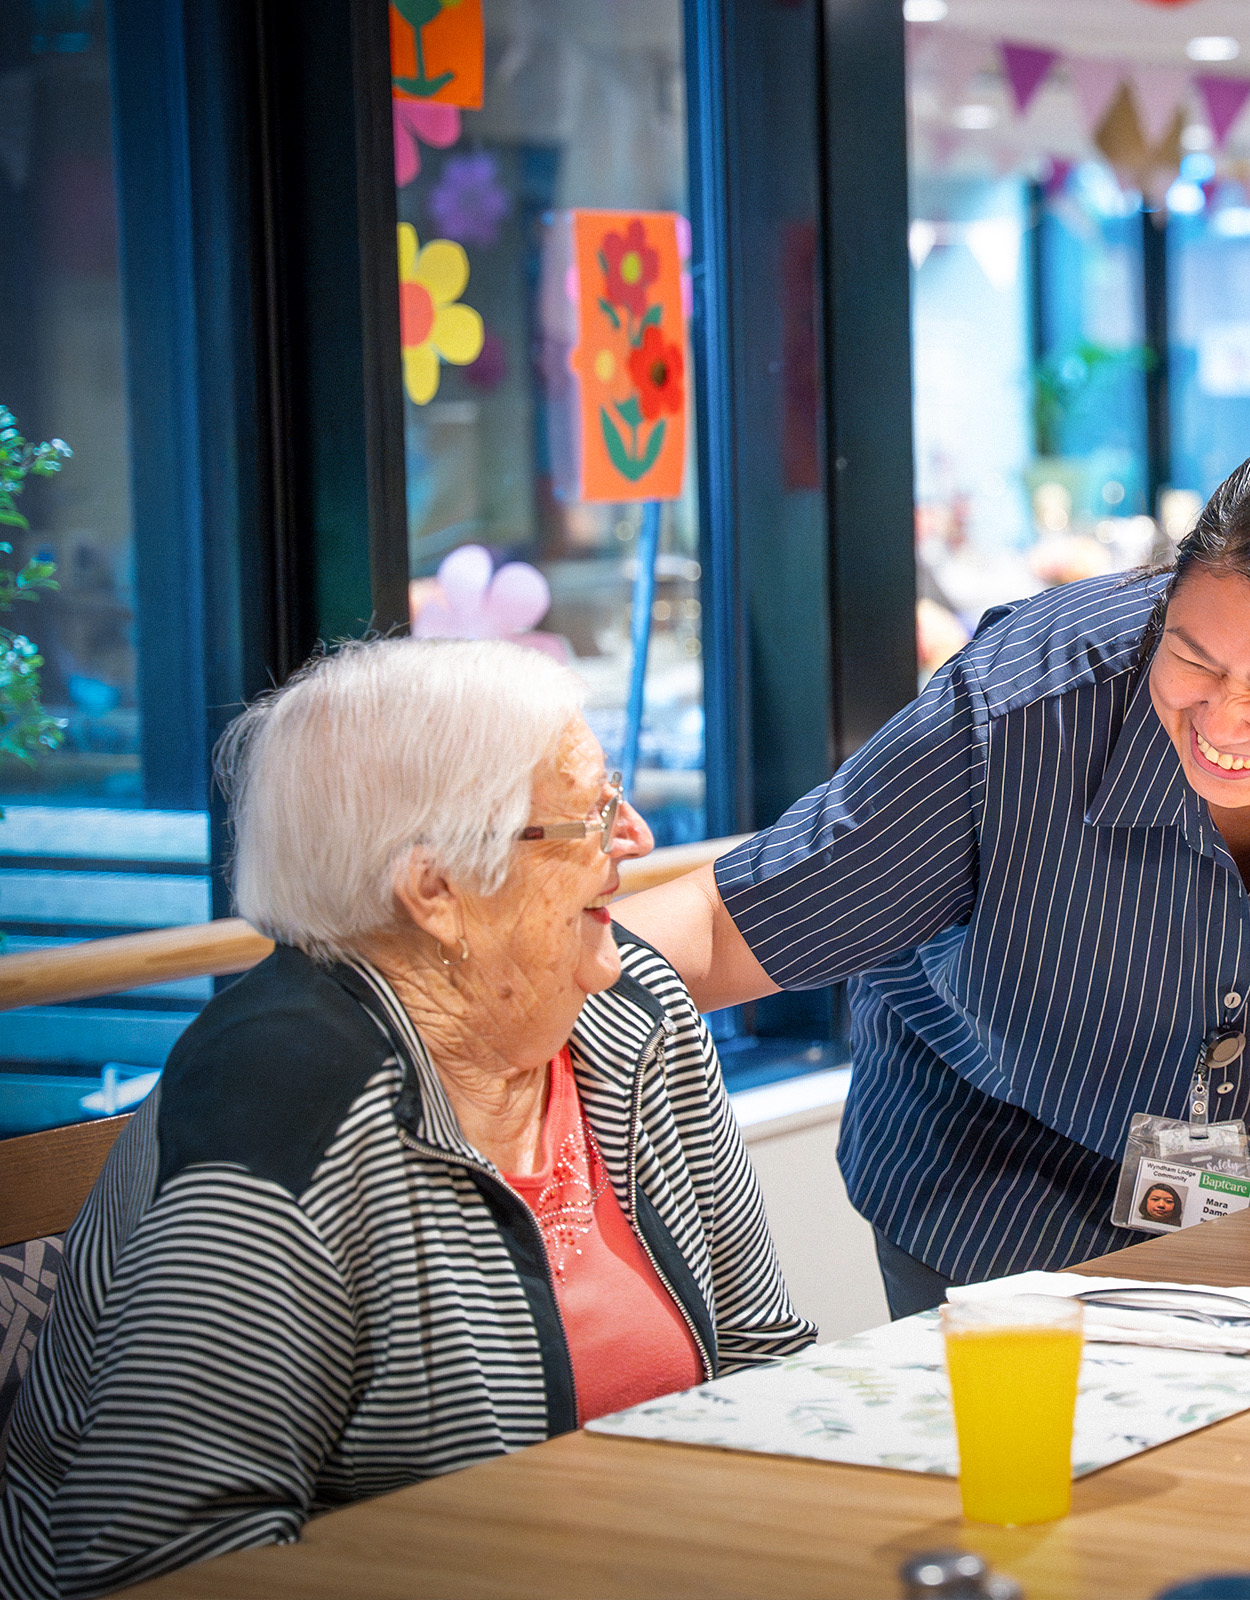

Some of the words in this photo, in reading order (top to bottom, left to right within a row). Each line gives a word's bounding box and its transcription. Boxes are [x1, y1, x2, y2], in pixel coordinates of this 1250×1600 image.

[1147, 1162, 1176, 1172] Wyndham
[1177, 1168, 1196, 1177] Lodge
[1153, 1171, 1187, 1182] Community
[1202, 1174, 1247, 1193] Baptcare
[1206, 1198, 1228, 1209] Mara
